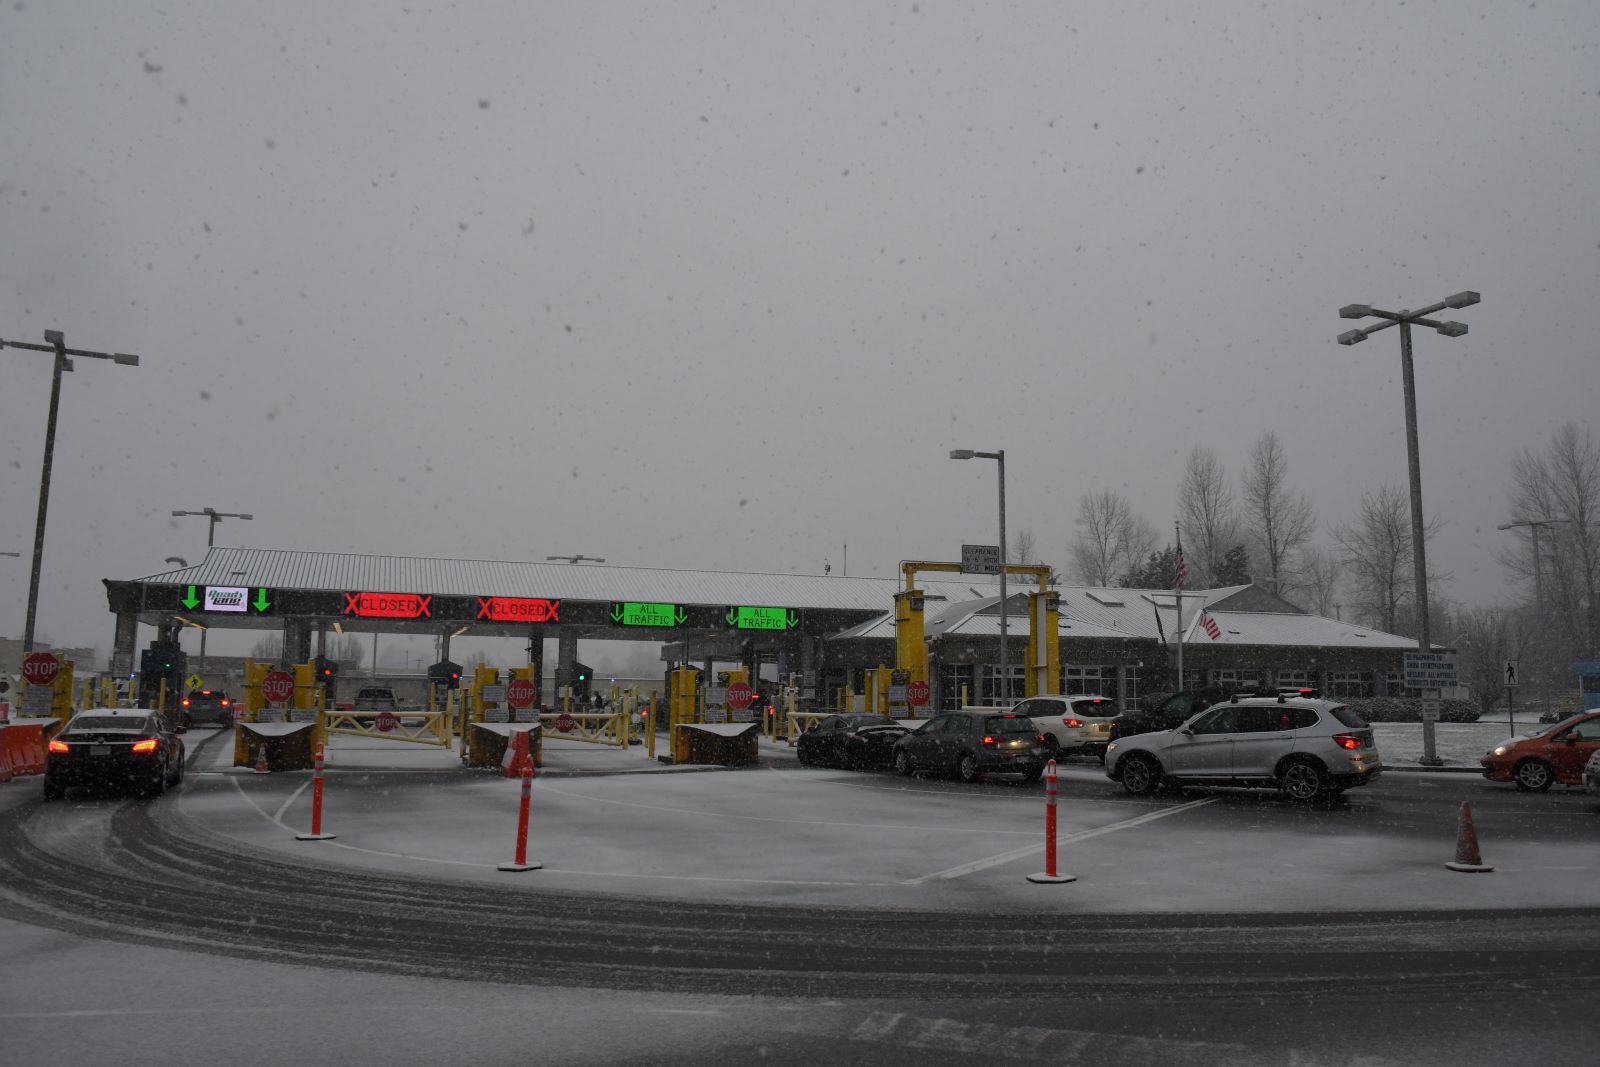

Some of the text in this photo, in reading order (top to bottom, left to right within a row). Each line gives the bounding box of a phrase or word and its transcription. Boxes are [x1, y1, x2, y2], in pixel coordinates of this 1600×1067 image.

[360, 595, 417, 612] CLOSED
[492, 599, 545, 616] CLOSED
[640, 604, 658, 614] ALL
[753, 608, 771, 618] ALL
[629, 614, 669, 625] TRAFFIC
[743, 618, 781, 628] TRAFFIC
[24, 662, 58, 675] STOP
[264, 680, 293, 693] STOP
[509, 687, 535, 699] STOP
[728, 690, 752, 701] STOP
[908, 688, 929, 699] STOP
[557, 719, 573, 727] STOP
